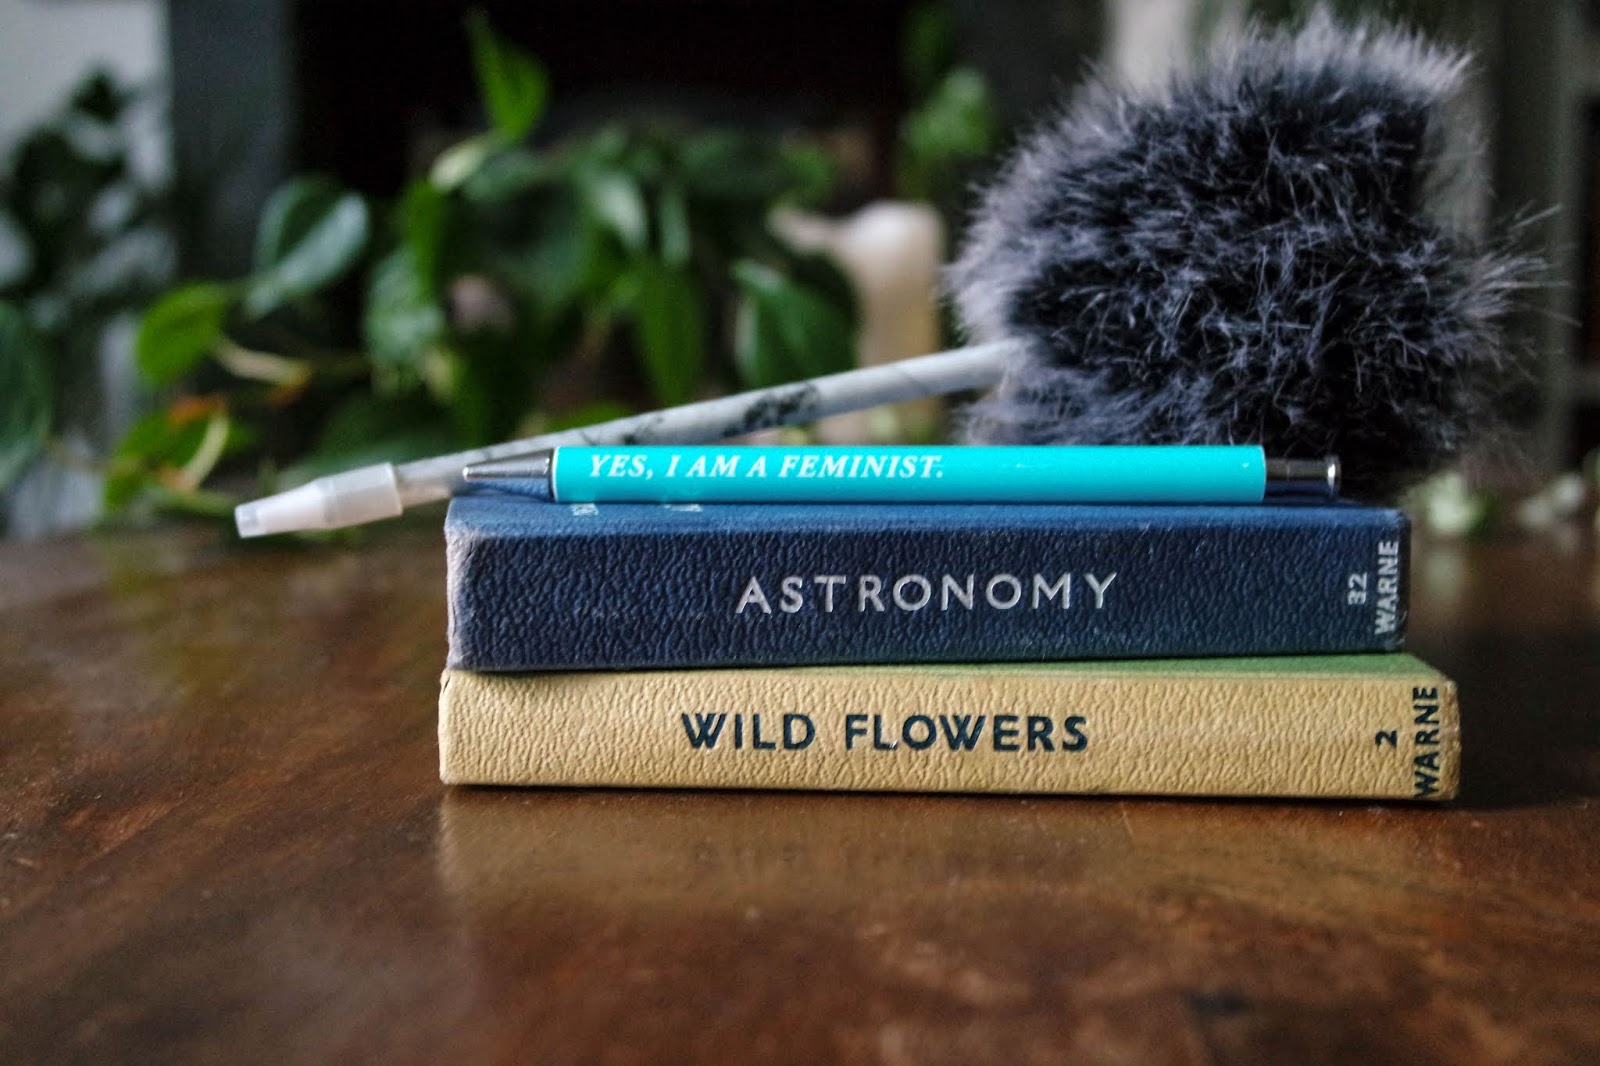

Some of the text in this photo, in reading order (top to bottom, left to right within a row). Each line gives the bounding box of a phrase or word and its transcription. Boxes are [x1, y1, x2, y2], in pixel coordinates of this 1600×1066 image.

[589, 455, 944, 480] YES, I AM A FEMINIST.
[735, 572, 1117, 614] ASTRONOMY
[1348, 571, 1367, 605] 32
[1375, 540, 1399, 635] WARNE
[681, 712, 1089, 752] WILD FLOWERS
[1375, 730, 1398, 749] 2
[1413, 686, 1440, 799] WARNE
